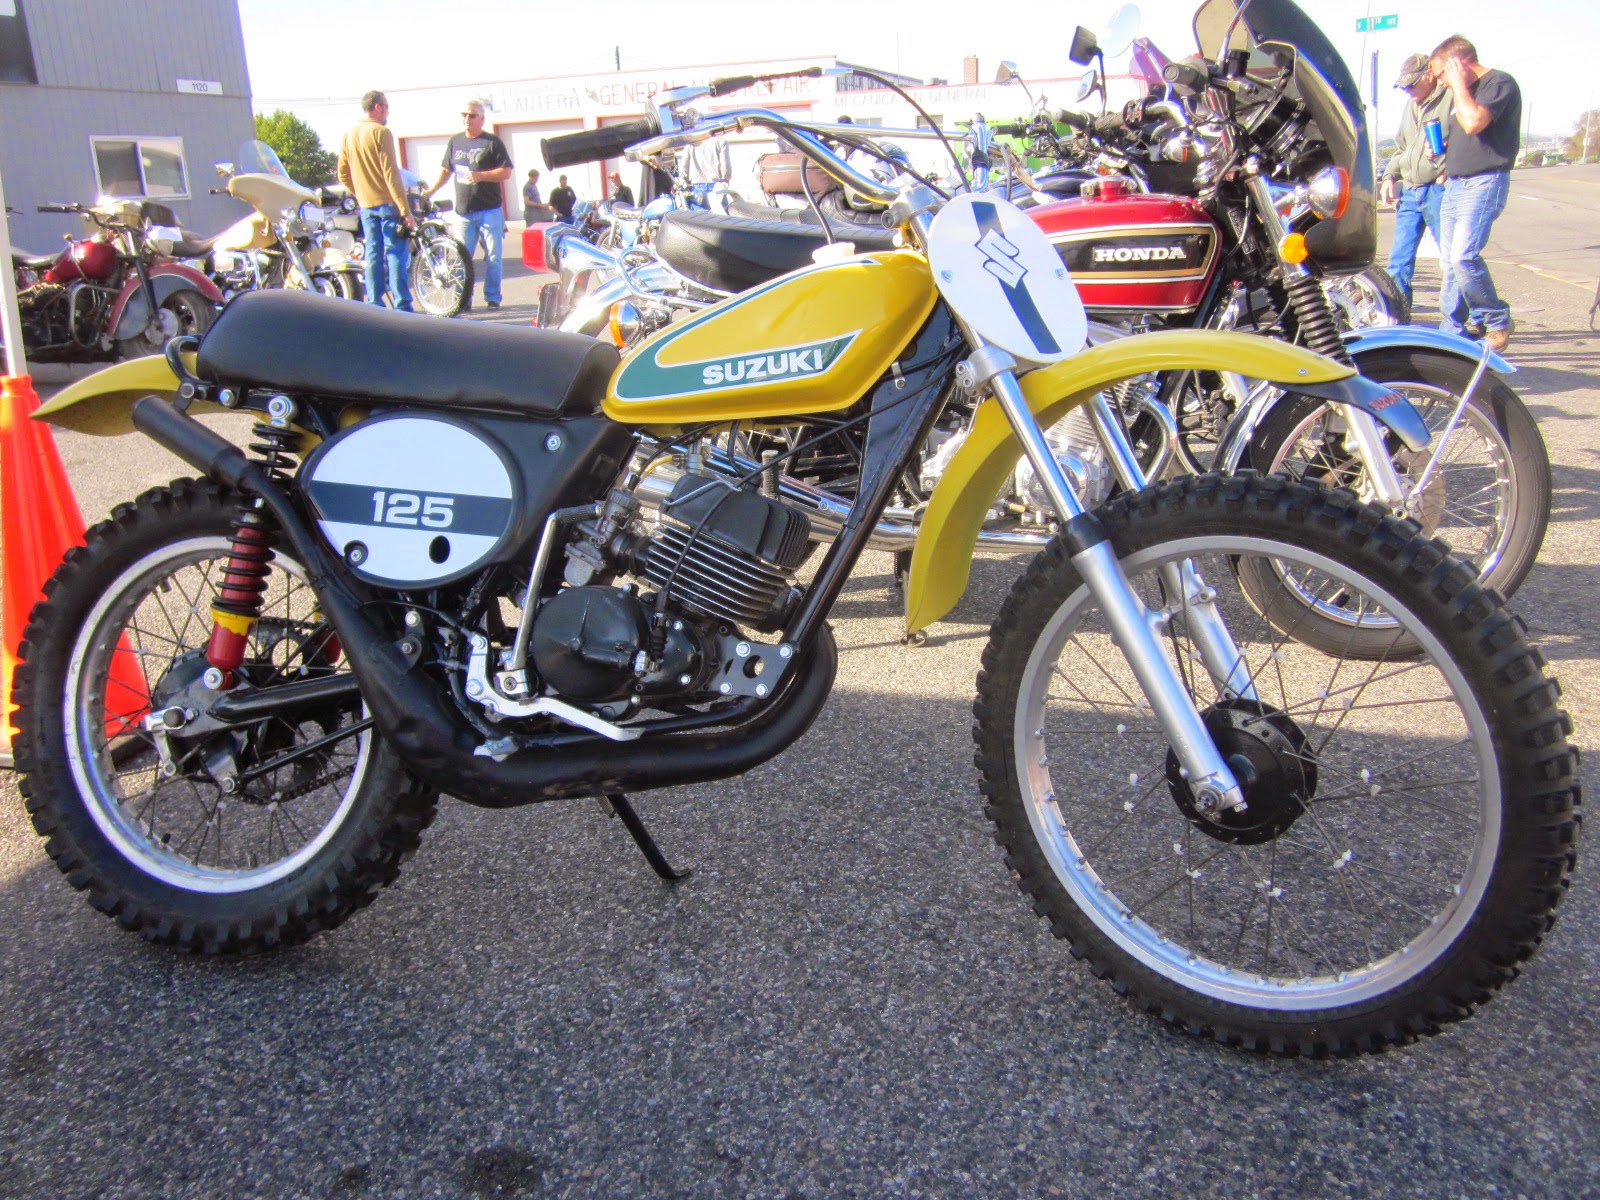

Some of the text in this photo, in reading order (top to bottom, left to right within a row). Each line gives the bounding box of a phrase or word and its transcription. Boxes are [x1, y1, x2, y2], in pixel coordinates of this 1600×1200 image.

[1386, 17, 1397, 27] AVE
[192, 82, 208, 92] 1120
[1094, 247, 1186, 262] HONDA
[702, 348, 823, 385] SUZUKI
[372, 491, 454, 528] 125
